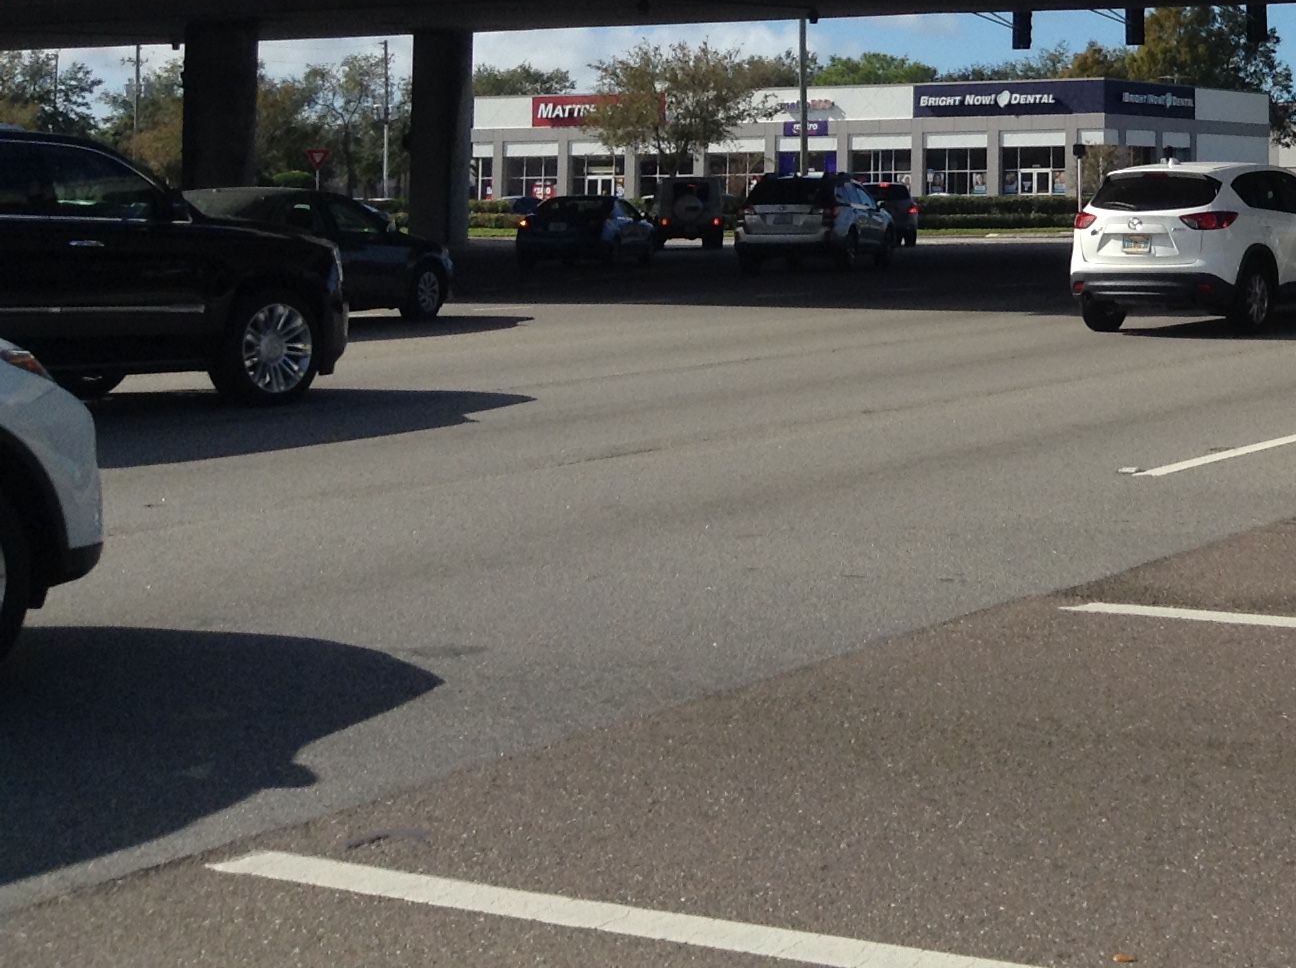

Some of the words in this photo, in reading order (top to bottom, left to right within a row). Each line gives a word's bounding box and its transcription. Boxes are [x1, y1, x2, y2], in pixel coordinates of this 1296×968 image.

[919, 95, 962, 107] BRIGHT
[964, 93, 997, 106] NOW!
[1010, 93, 1056, 105] DENTAL
